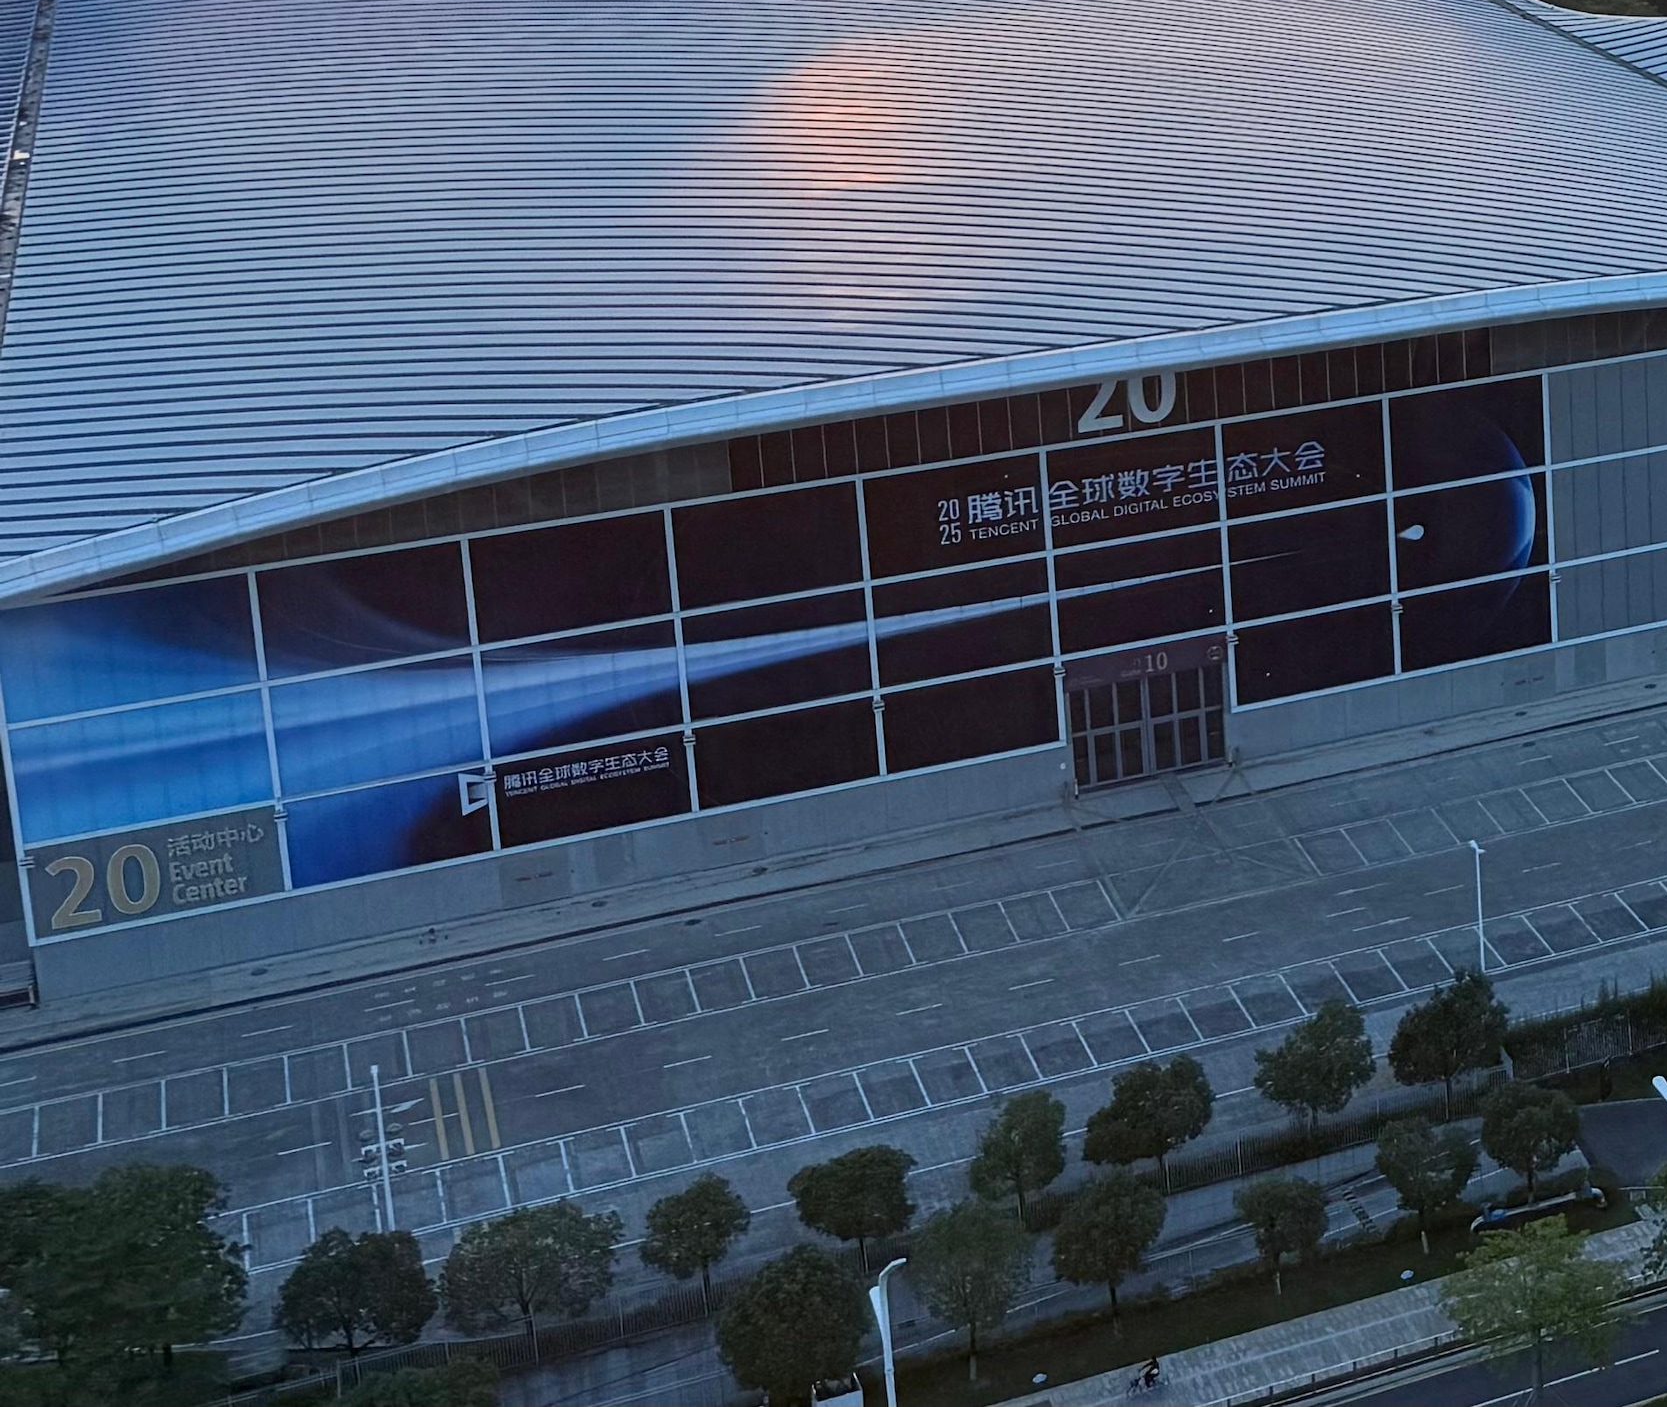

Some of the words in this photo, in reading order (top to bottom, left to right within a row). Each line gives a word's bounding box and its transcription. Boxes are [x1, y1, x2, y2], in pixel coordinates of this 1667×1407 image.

[1078, 371, 1176, 433] 20
[967, 441, 1326, 524] 腾讯全球数字生态大会
[938, 498, 960, 522] 20
[969, 519, 1039, 540] TENCENT
[1050, 508, 1109, 527] GLOBAL
[1113, 499, 1169, 517] DIGITAL
[1270, 471, 1326, 491] SUMMIT
[939, 522, 962, 545] 25
[1145, 652, 1168, 673] 10
[503, 747, 669, 790] 腾讯全球数字生态大会
[167, 824, 264, 858] 活动中心
[168, 853, 234, 884] Event
[45, 844, 160, 930] 20
[172, 876, 248, 906] Center
